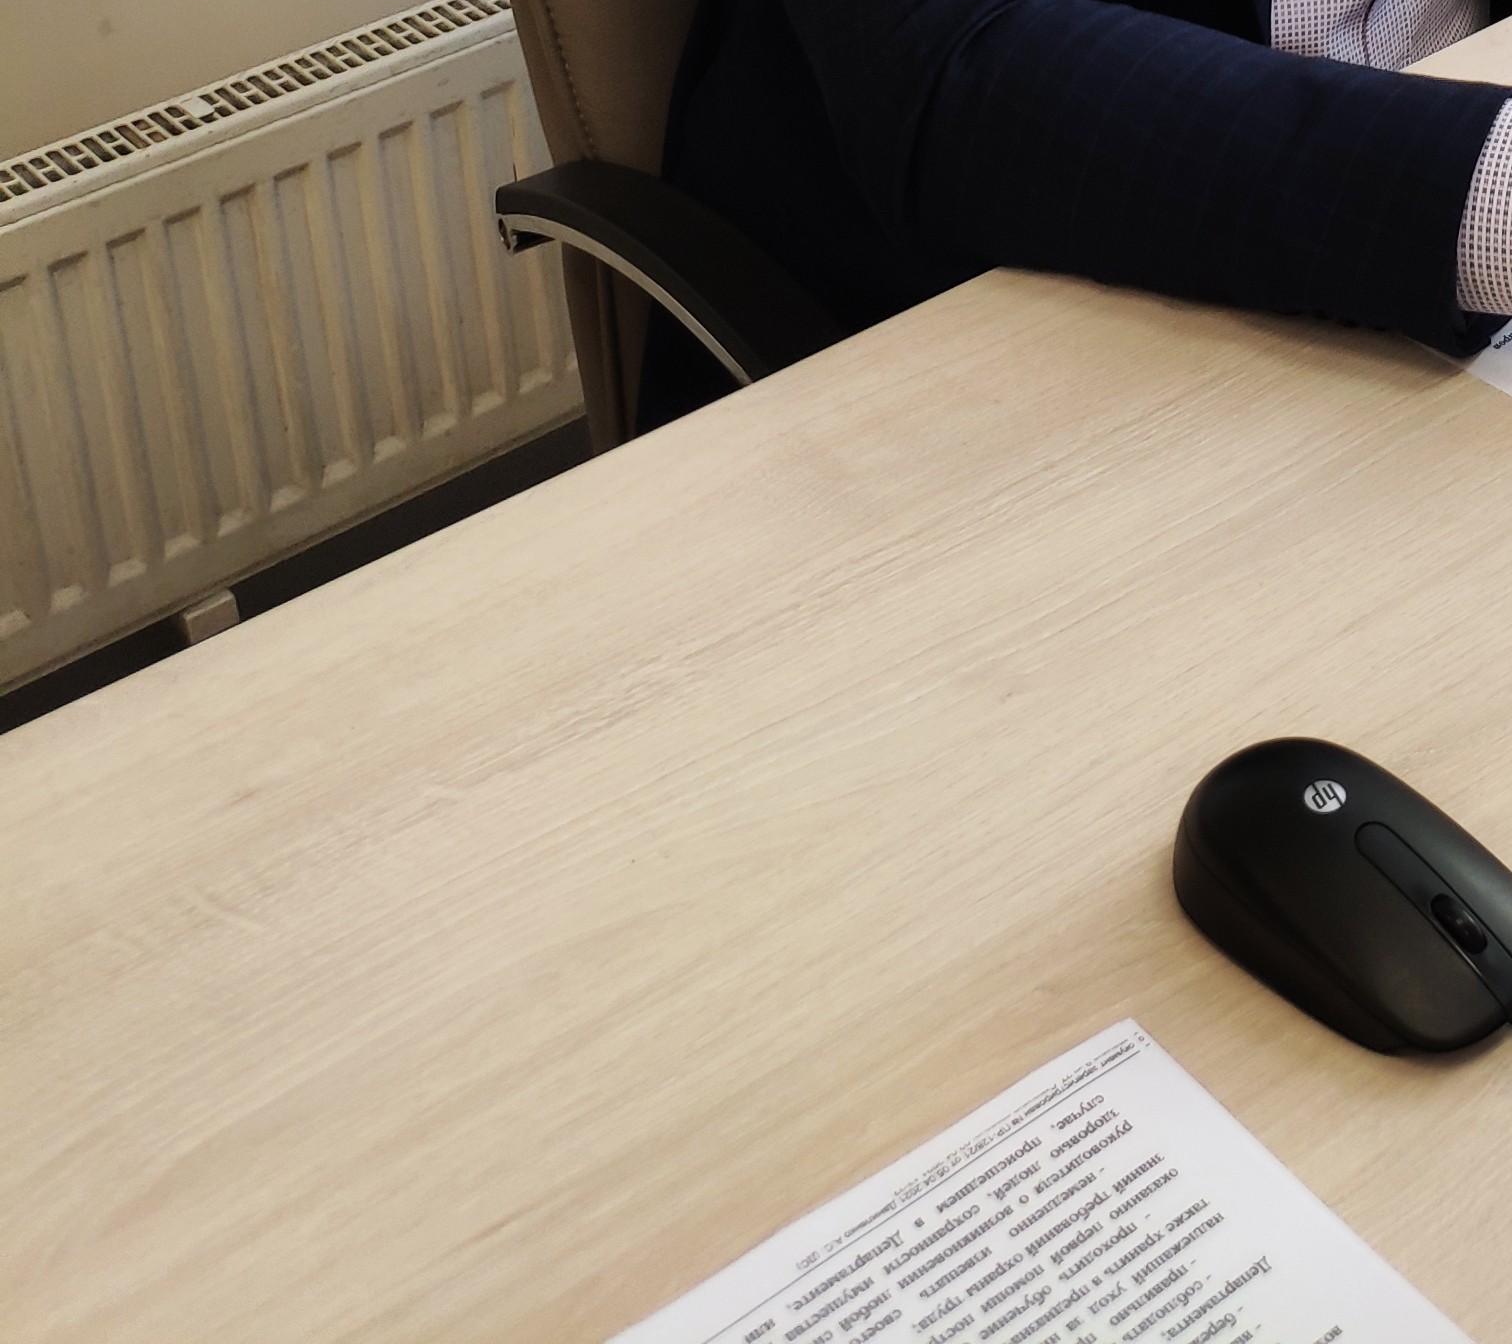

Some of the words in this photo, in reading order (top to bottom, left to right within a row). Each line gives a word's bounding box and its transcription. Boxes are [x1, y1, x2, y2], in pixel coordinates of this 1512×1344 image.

[1306, 779, 1346, 813] hp
[1050, 1095, 1104, 1130] случае,
[1050, 1109, 1119, 1158] здоровью
[936, 1137, 1042, 1213] происшедшем
[987, 1161, 1041, 1201] людей,
[1034, 1119, 1133, 1195] руководителя
[1112, 1154, 1165, 1195] знаний
[1009, 1172, 1097, 1237] немедленно
[1109, 1168, 1178, 1220] оказанию
[1165, 1199, 1208, 1232] также
[882, 1205, 980, 1275] сохранности
[897, 1205, 1014, 1290] возникновении
[1025, 1191, 1112, 1257] требований
[1050, 1221, 1103, 1266] первой
[1058, 1222, 1138, 1281] проходить
[1131, 1213, 1224, 1286] надлежащий
[787, 1230, 904, 1311] Департаменте,
[919, 1247, 992, 1298] извещать
[966, 1253, 1023, 1297] охраны
[980, 1264, 1045, 1314] помощи
[1087, 1281, 1127, 1315] уход
[1109, 1264, 1189, 1326] правильно
[1161, 1255, 1272, 1341] Департамента;
[784, 1277, 875, 1342] имущества
[912, 1296, 964, 1334] труда;
[979, 1285, 1052, 1340] обучение
[1122, 1281, 1203, 1342] соблюдать
